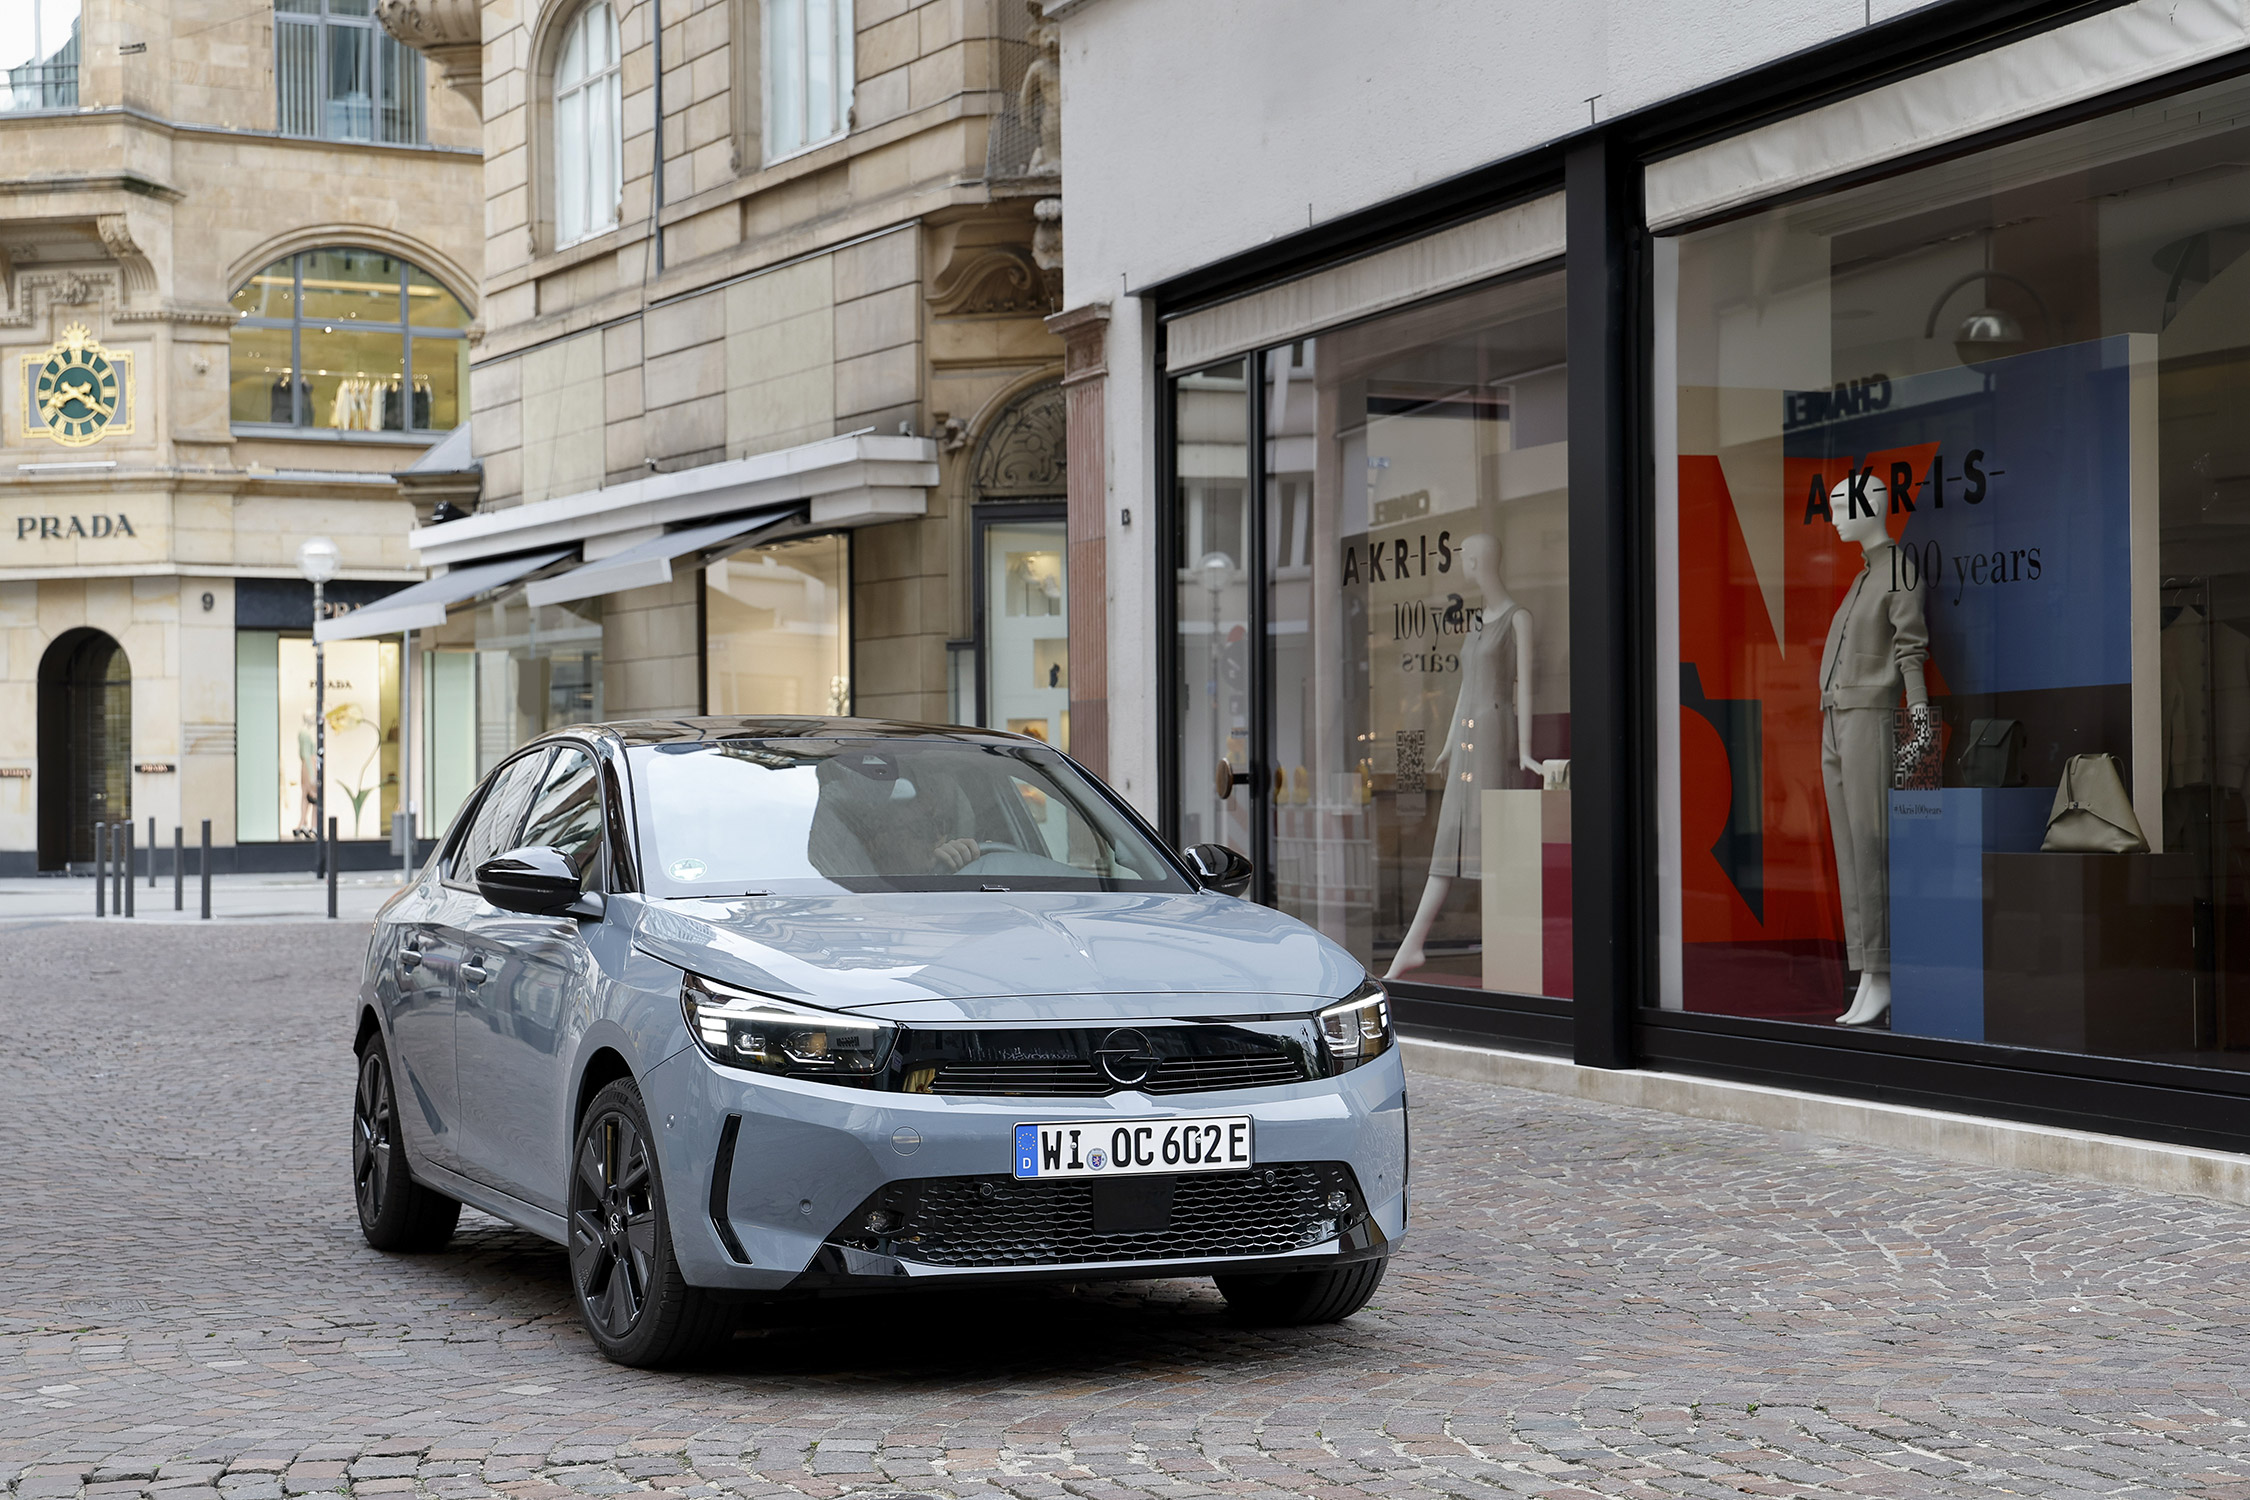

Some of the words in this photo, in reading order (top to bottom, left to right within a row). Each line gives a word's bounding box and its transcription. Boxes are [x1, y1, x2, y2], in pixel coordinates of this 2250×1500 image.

[17, 514, 136, 540] PRADA
[1888, 540, 1942, 593] 100
[1952, 547, 2042, 606] years
[202, 592, 215, 612] 9
[1393, 600, 1426, 640] 100
[1431, 606, 1483, 651] years
[1894, 803, 1942, 819] #Akris100years
[1022, 1157, 1032, 1170] D
[1041, 1130, 1084, 1170] WI
[1111, 1127, 1154, 1168] OC
[1162, 1123, 1248, 1165] 602E
